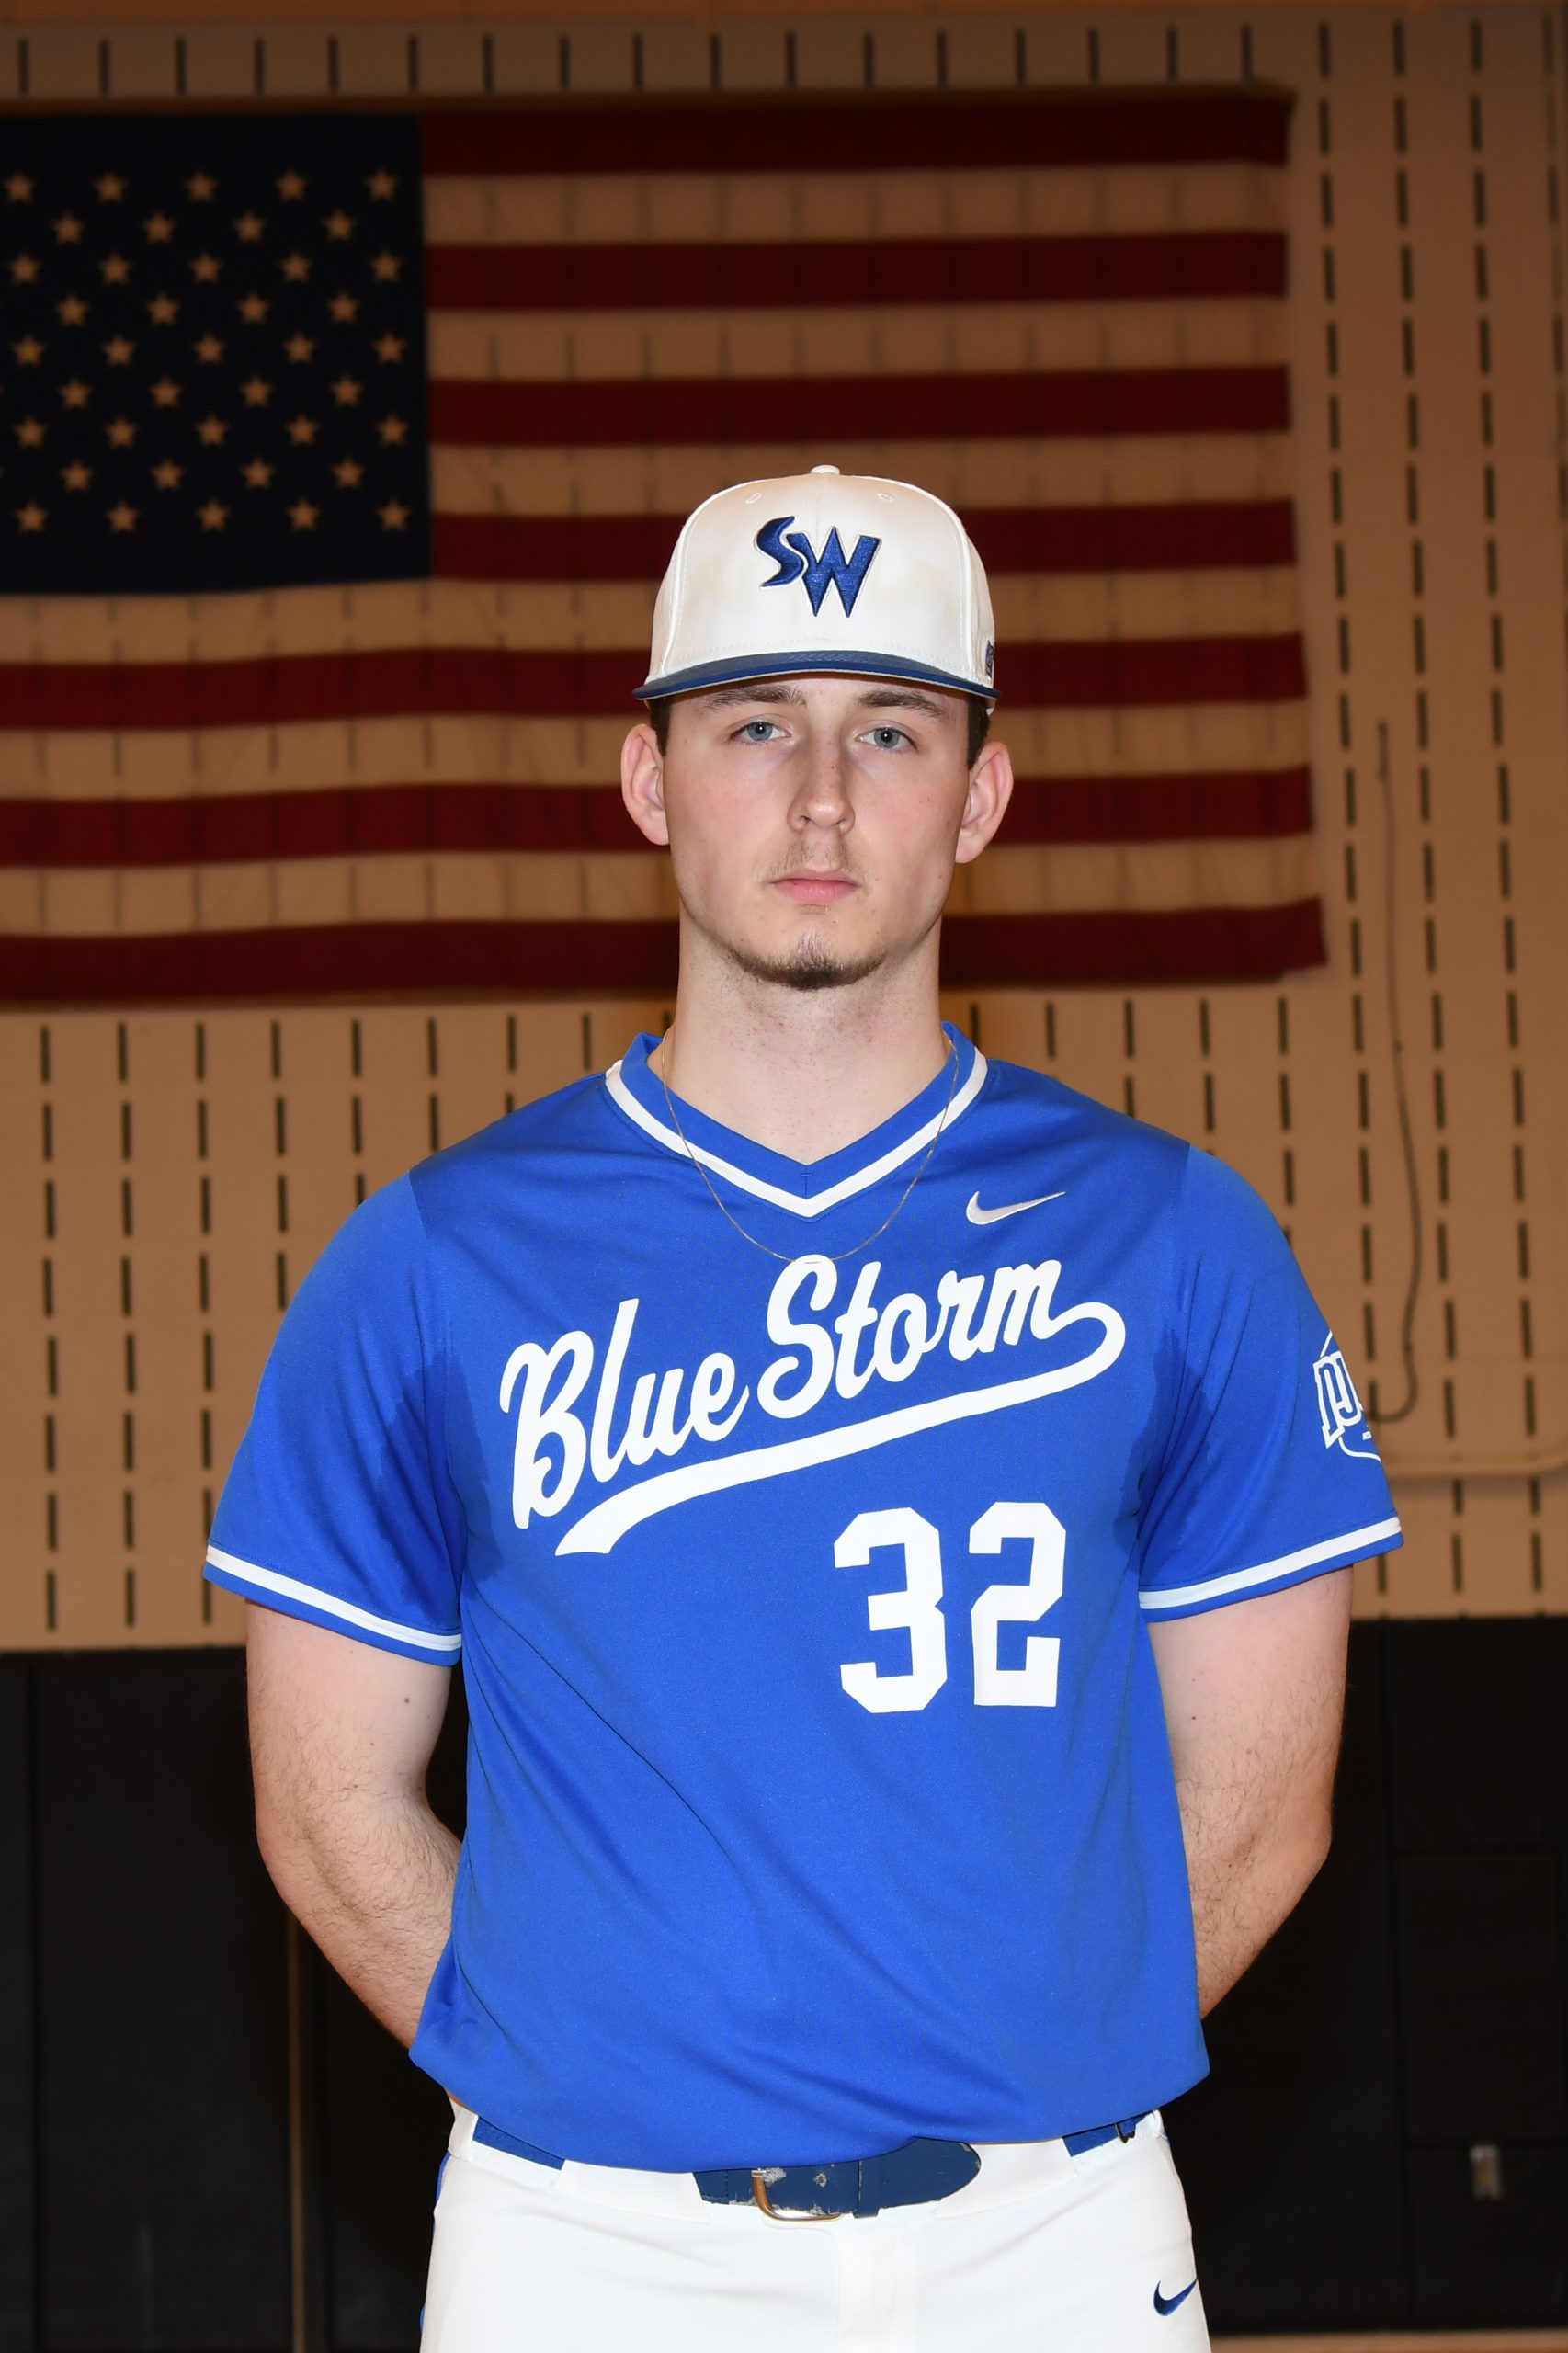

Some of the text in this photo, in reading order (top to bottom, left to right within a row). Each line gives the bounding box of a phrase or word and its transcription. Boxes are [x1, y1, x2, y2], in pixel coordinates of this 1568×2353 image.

[755, 515, 882, 618] SW
[499, 1253, 1064, 1529] Blue Storm
[833, 1501, 1066, 1714] 32
